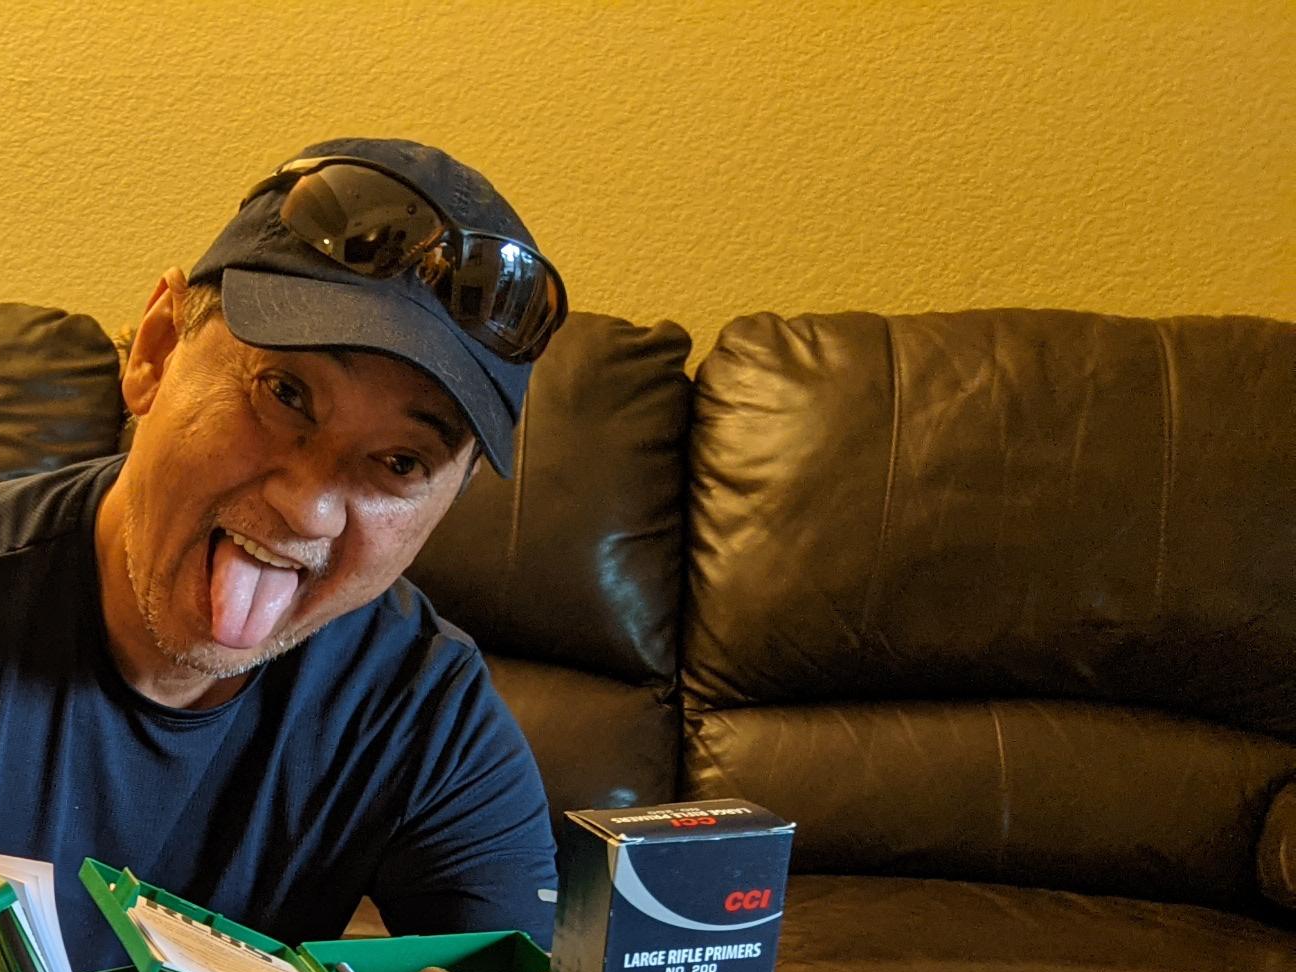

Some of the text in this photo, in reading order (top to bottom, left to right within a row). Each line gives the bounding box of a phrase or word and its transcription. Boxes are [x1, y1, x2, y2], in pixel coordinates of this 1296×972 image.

[724, 888, 772, 912] CCI
[623, 942, 762, 968] LARGE RIFLE PRIMERS
